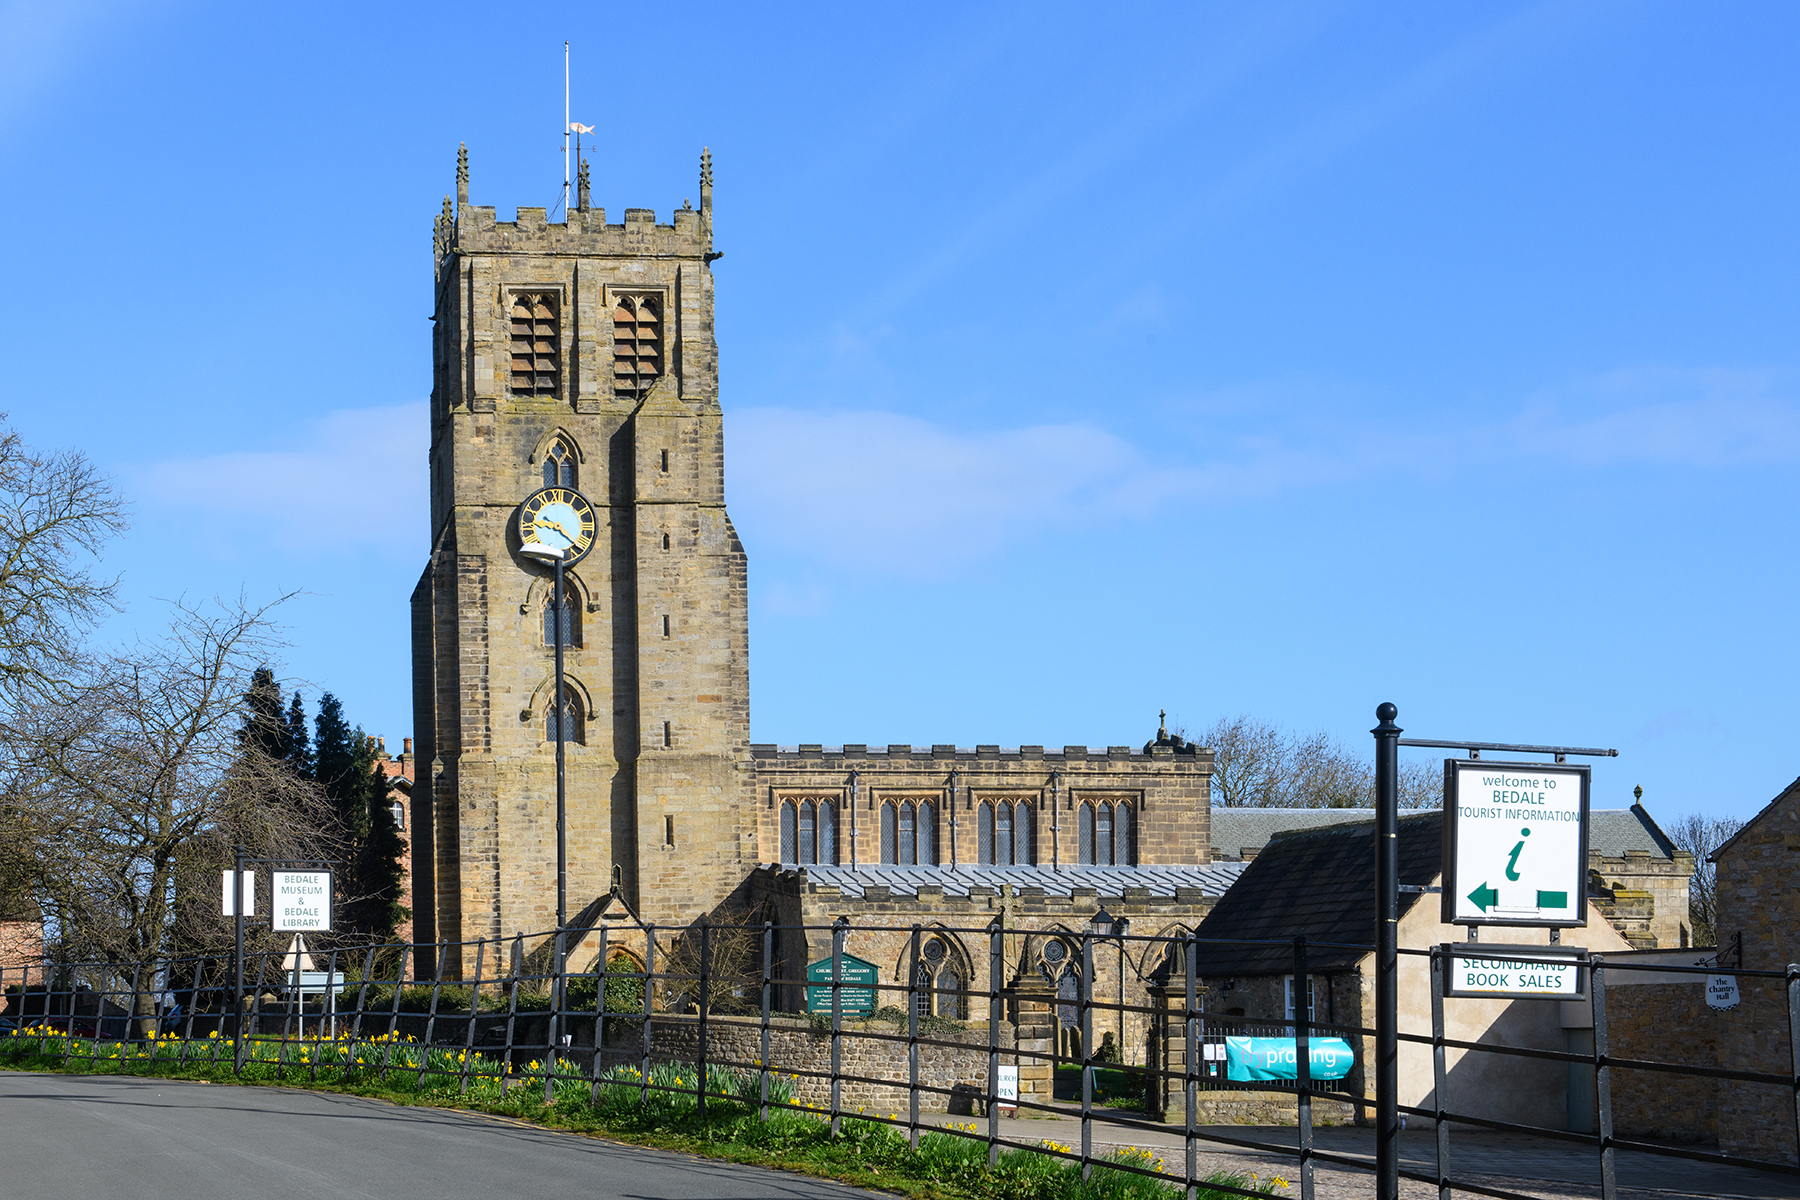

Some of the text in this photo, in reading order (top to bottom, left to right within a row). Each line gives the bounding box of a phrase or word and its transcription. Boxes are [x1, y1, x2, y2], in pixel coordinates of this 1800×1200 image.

[552, 490, 564, 503] XII
[1483, 774, 1557, 789] welcome to
[1493, 790, 1545, 805] BEDALE
[1458, 806, 1579, 822] TOURIST INFORMATION
[284, 875, 319, 883] BEDALE
[281, 886, 322, 894] MUSEUM
[298, 897, 304, 905] &
[284, 908, 319, 916] BEDALE
[283, 918, 320, 926] LIBRARY
[1463, 958, 1568, 972] SECONDHAND
[1467, 973, 1562, 988] BOOK SALES
[1240, 1048, 1341, 1069] trypraing.
